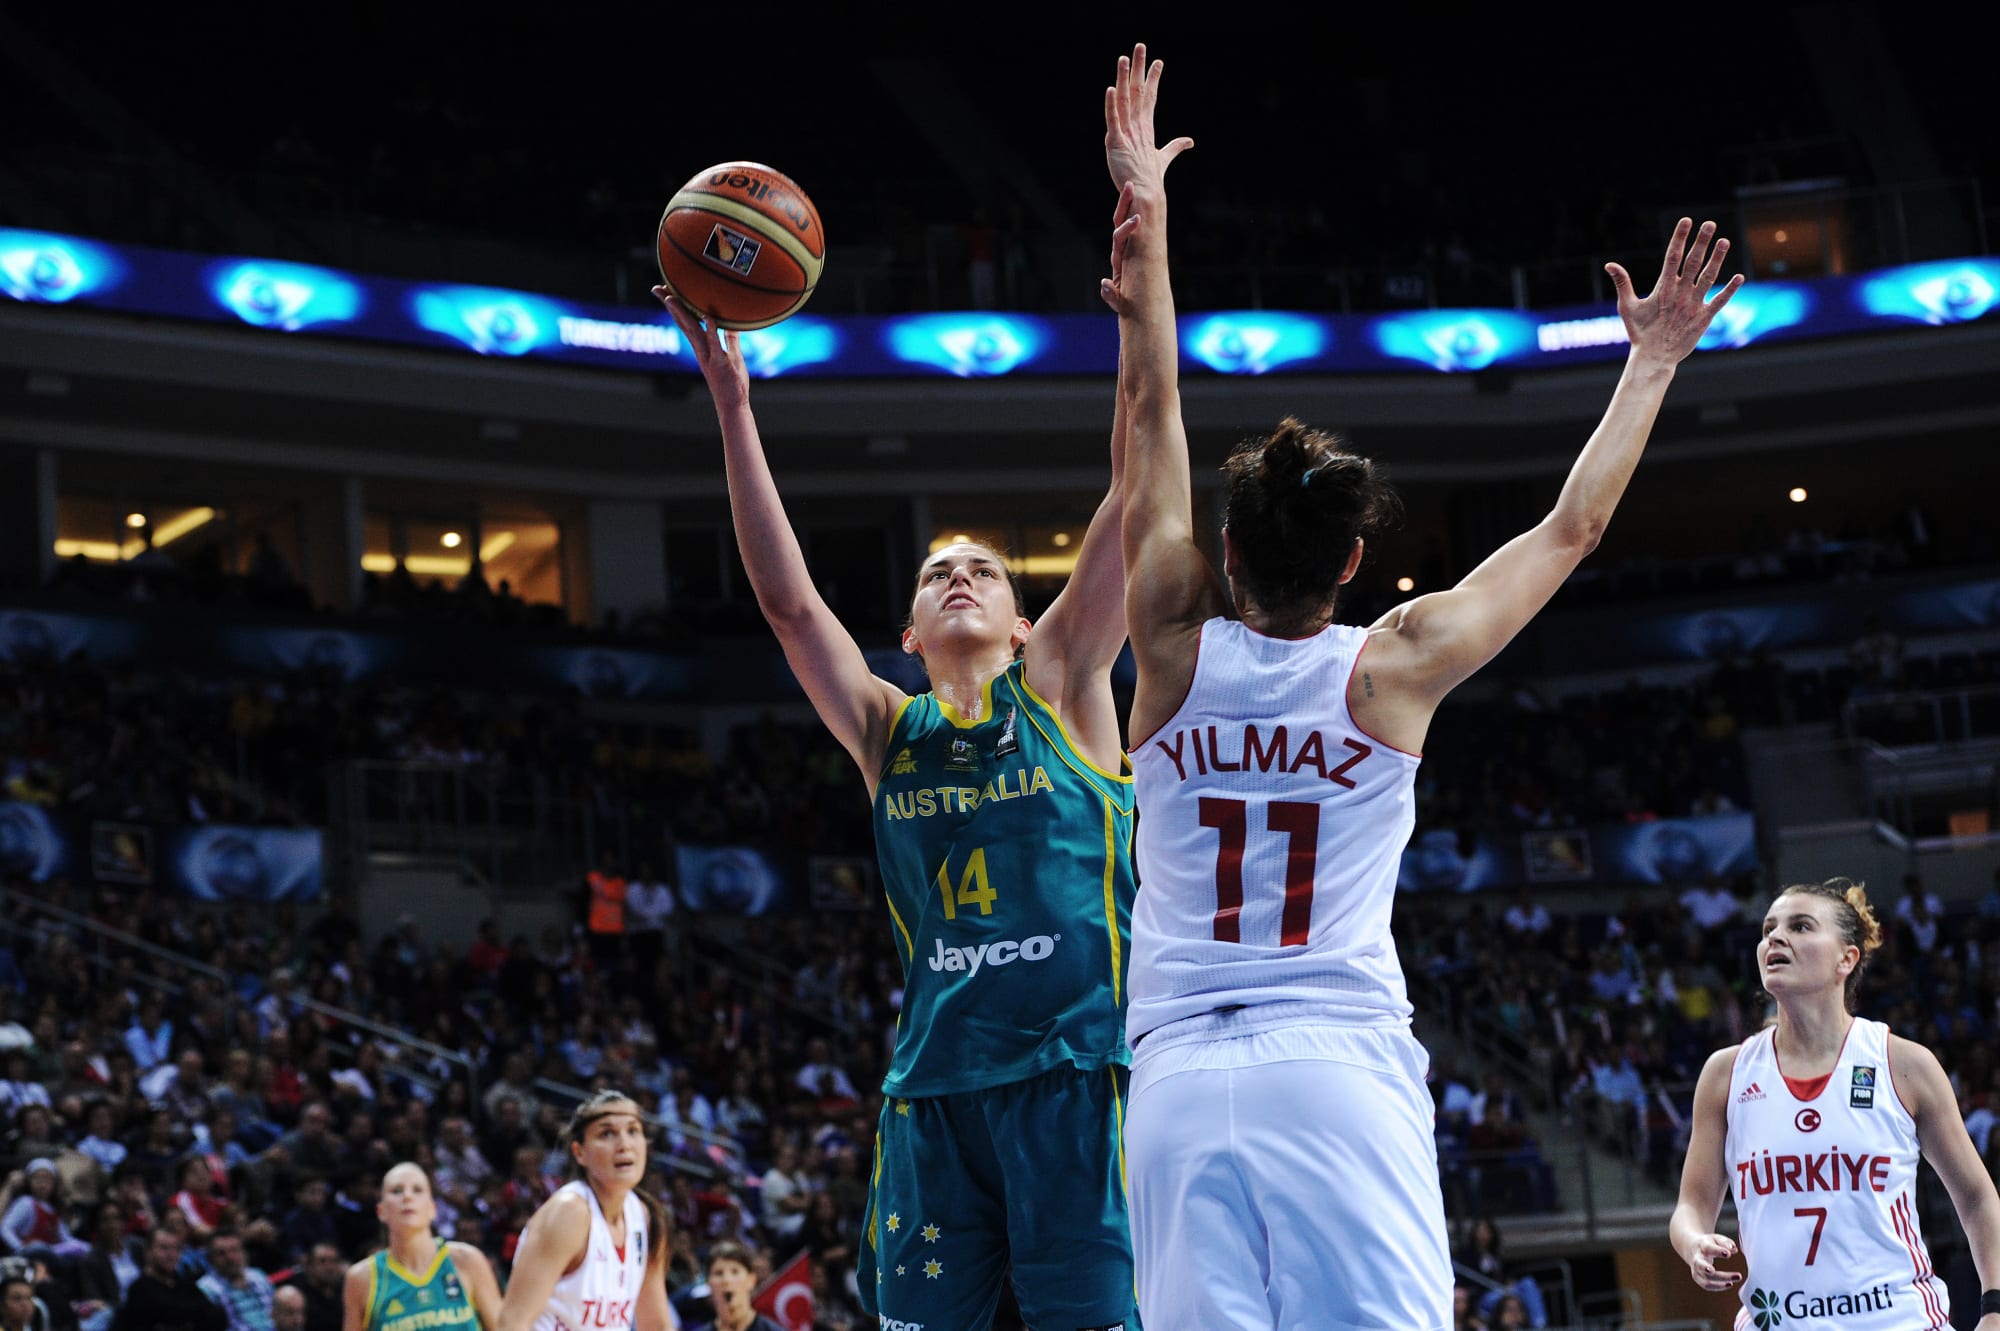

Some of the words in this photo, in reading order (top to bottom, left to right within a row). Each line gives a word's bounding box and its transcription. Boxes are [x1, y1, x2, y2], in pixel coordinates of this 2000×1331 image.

[710, 173, 809, 231] molten
[1156, 724, 1371, 789] YILMAZ
[886, 766, 1055, 821] AUSTRALIA
[938, 847, 998, 920] 14
[1198, 796, 1321, 947] 11
[1737, 1094, 1767, 1104] adidas
[1853, 1089, 1871, 1099] FIBA
[1737, 1145, 1891, 1200] TÜRKİYE
[1793, 1207, 1828, 1267] 7
[1784, 1283, 1893, 1320] Garanti
